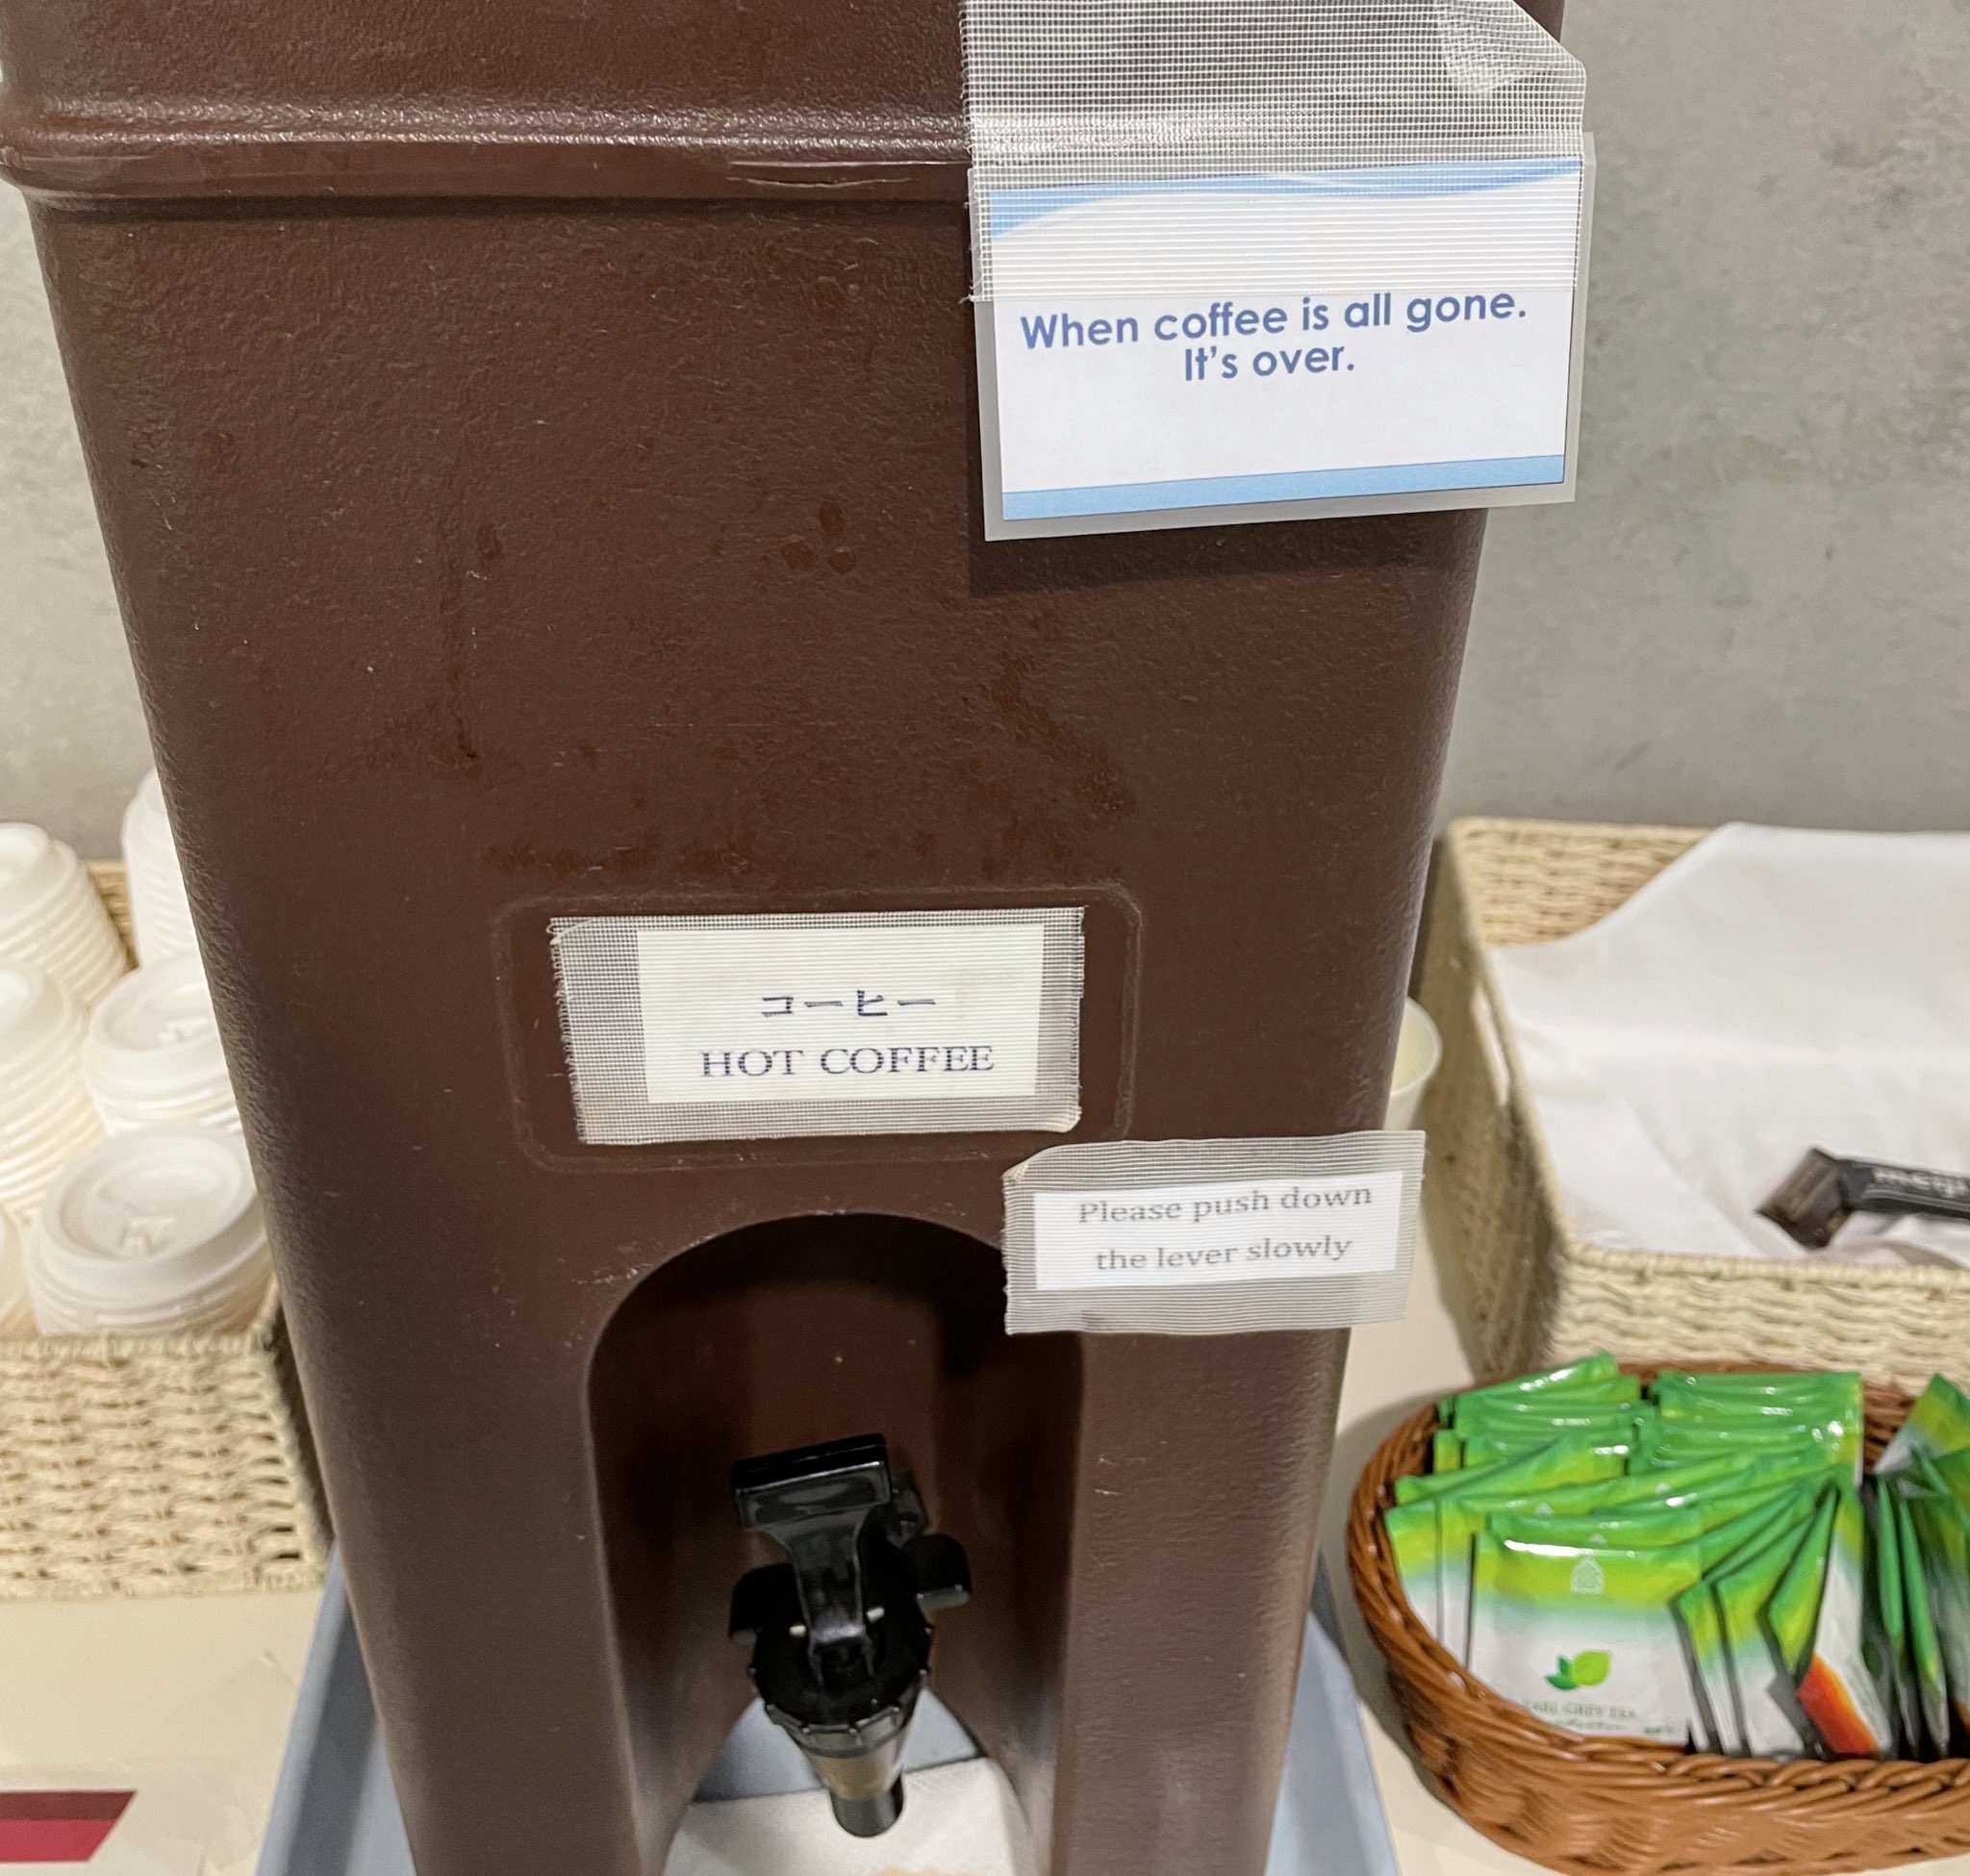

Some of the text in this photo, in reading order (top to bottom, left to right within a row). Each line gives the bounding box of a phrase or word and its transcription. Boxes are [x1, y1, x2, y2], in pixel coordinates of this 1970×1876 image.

[1020, 292, 1527, 350] When coffee is all gone.
[1251, 344, 1355, 377] over.
[761, 989, 937, 1018] コーヒー
[700, 1045, 995, 1077] HOT COFFEE
[1078, 1185, 1373, 1223] Please push down
[1096, 1234, 1352, 1270] the lever slowly
